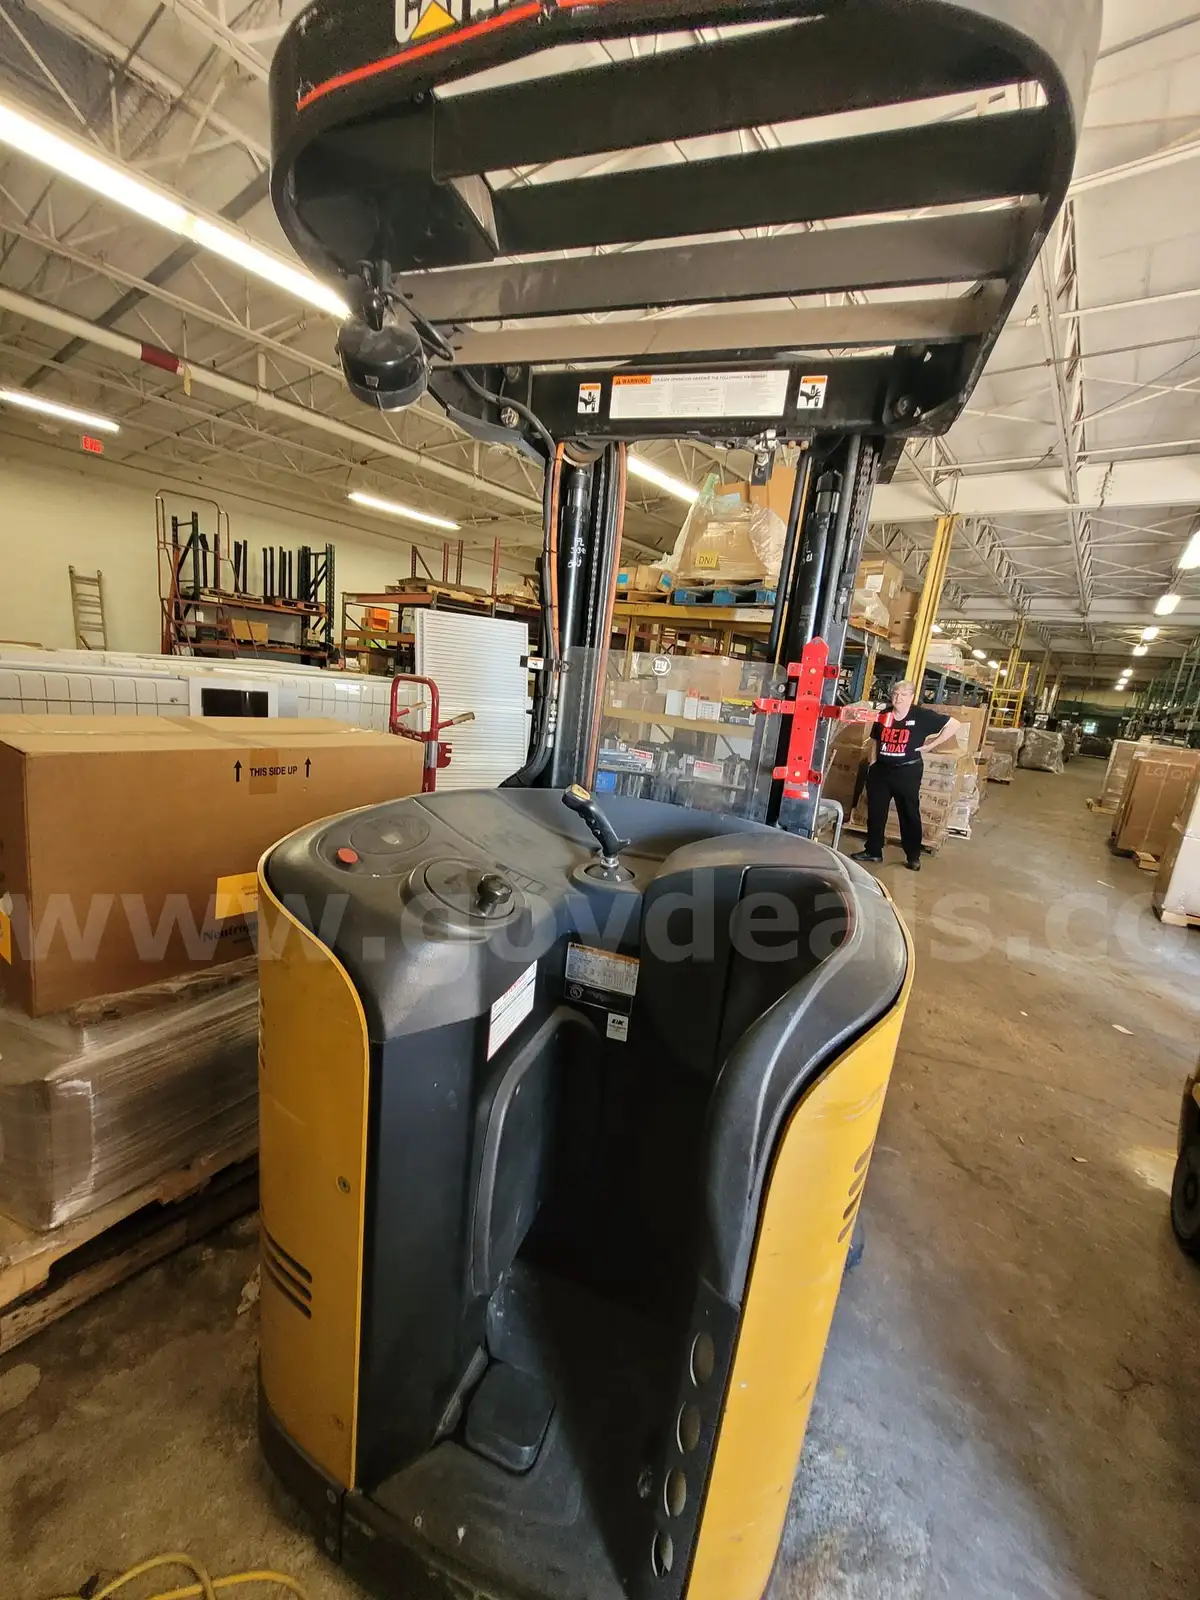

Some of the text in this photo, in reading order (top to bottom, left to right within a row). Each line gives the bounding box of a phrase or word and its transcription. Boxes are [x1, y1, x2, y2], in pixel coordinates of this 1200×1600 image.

[622, 377, 648, 385] WARNING
[881, 727, 910, 744] RED
[249, 765, 298, 777] THIS SIDE UP
